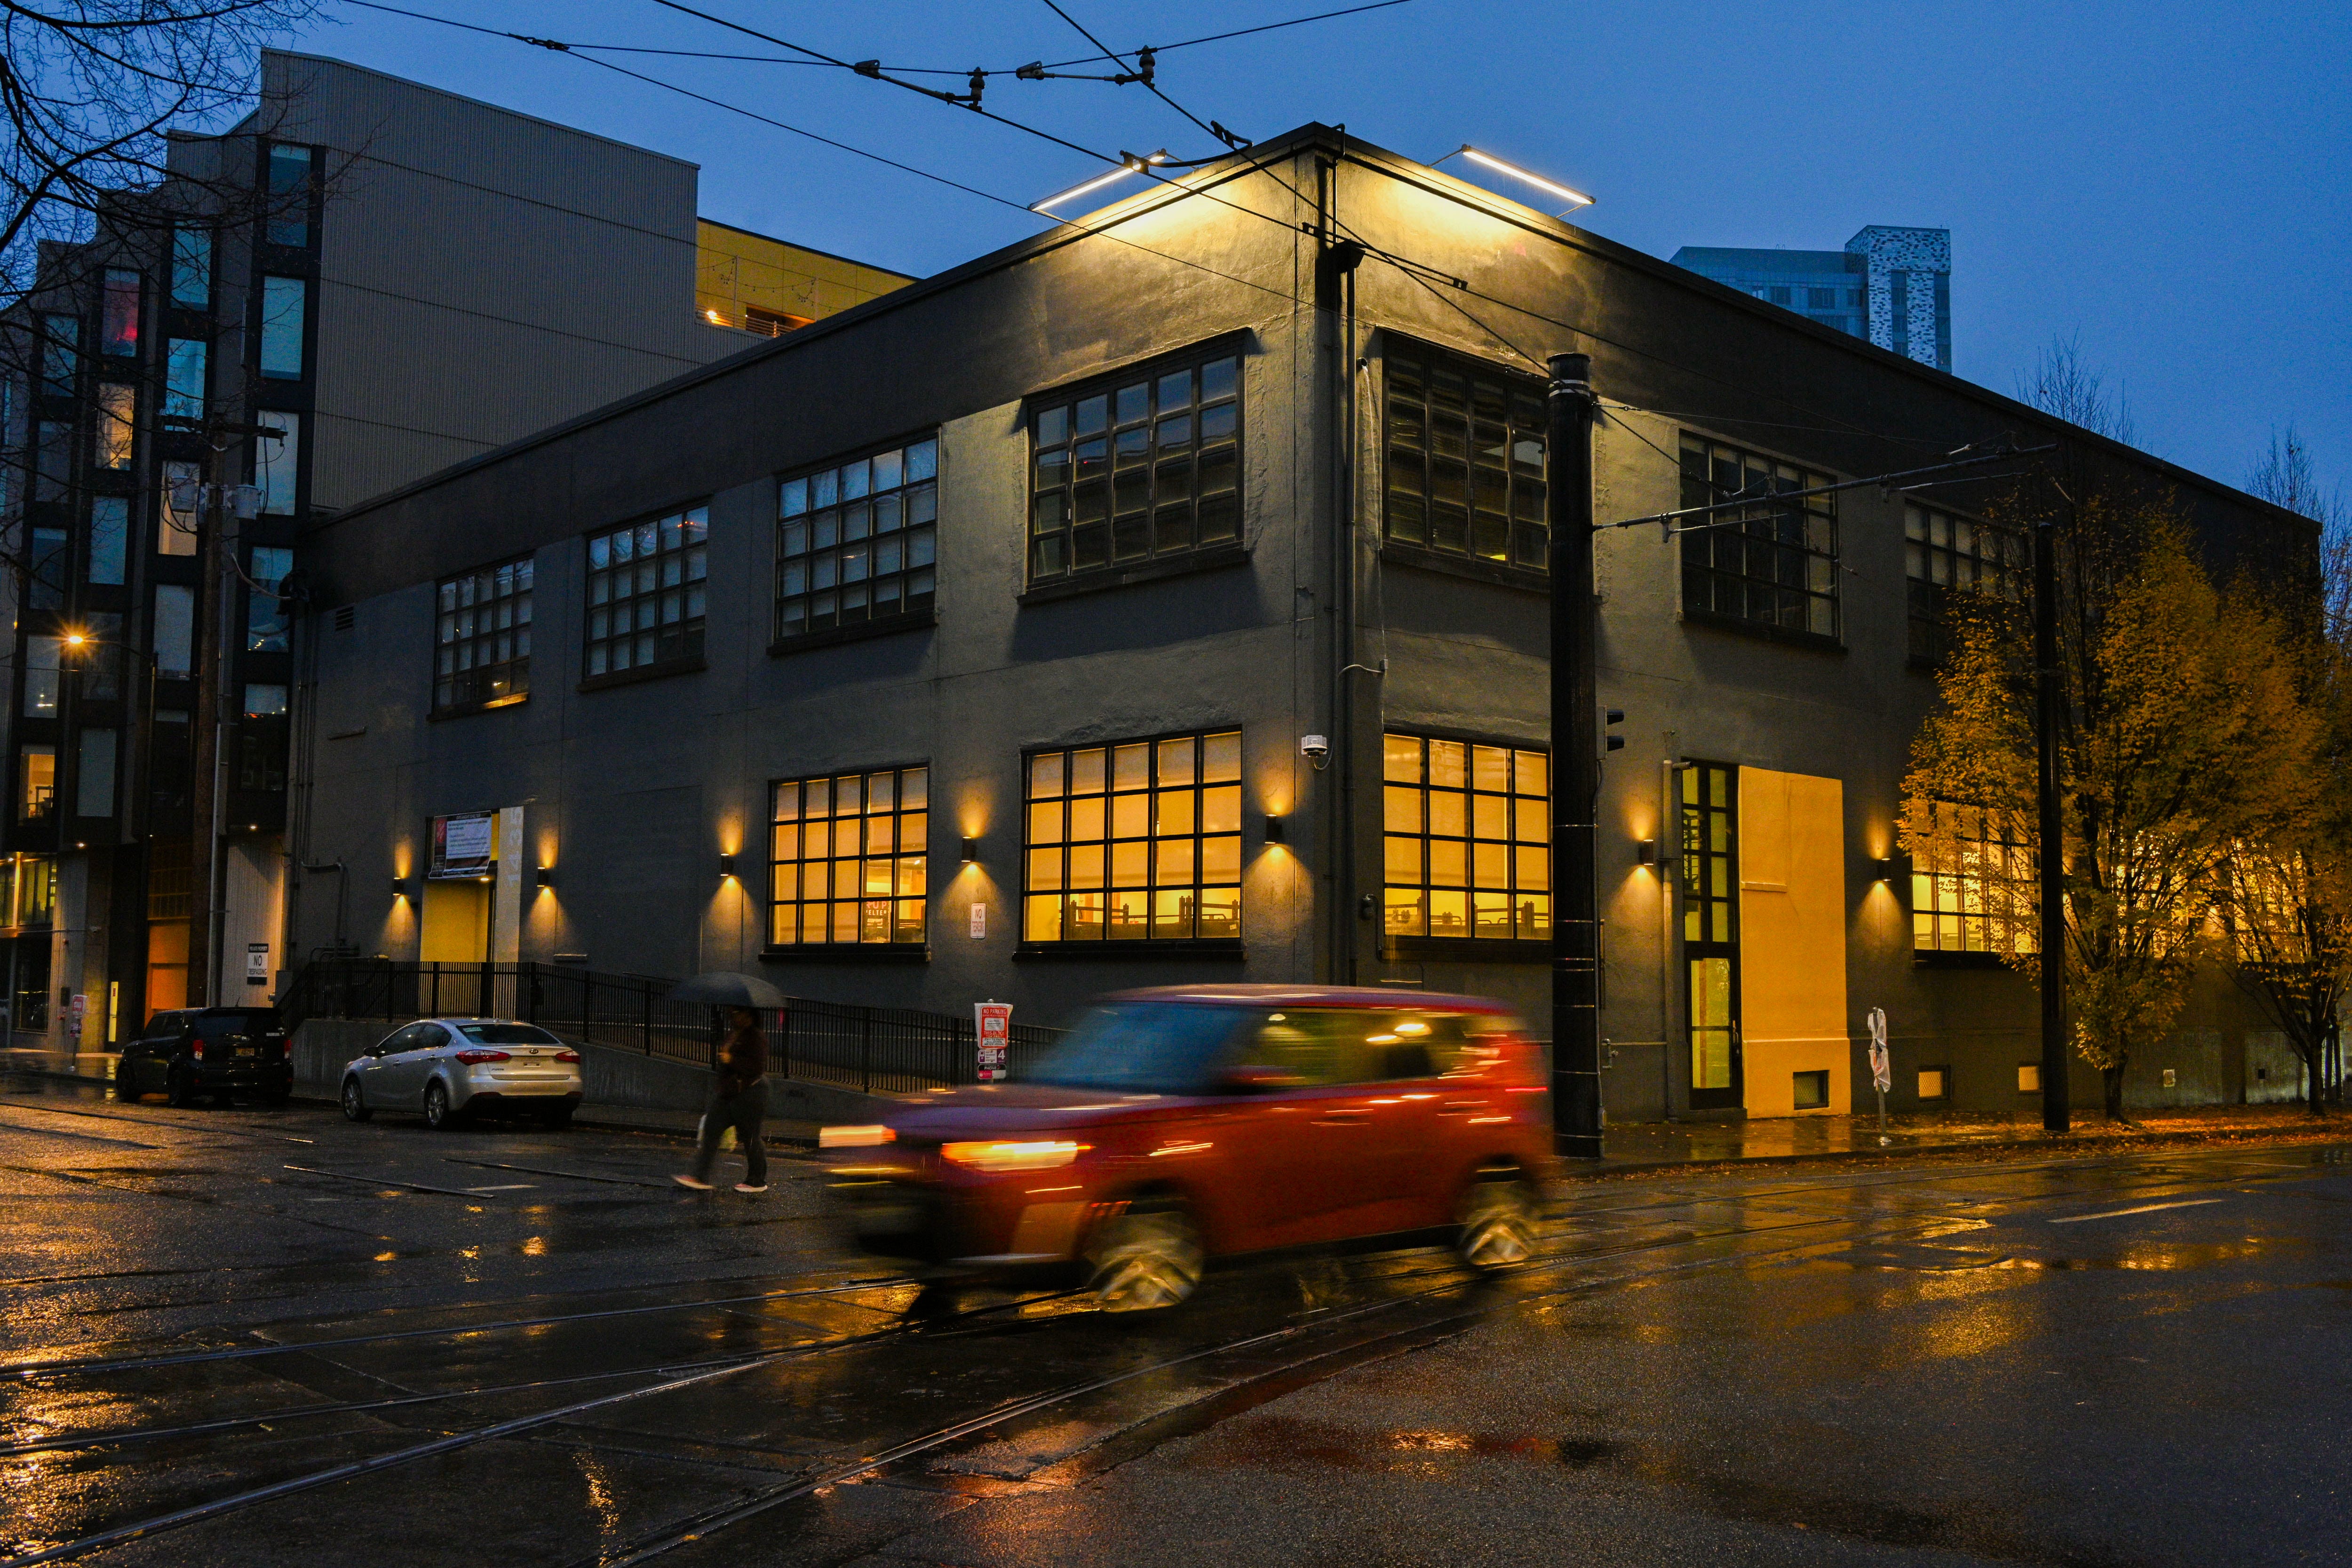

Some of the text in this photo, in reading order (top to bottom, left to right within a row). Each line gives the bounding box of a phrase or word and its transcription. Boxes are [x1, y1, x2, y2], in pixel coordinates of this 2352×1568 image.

[975, 908, 982, 919] NO
[254, 955, 262, 966] NO
[998, 1050, 1005, 1059] 4
